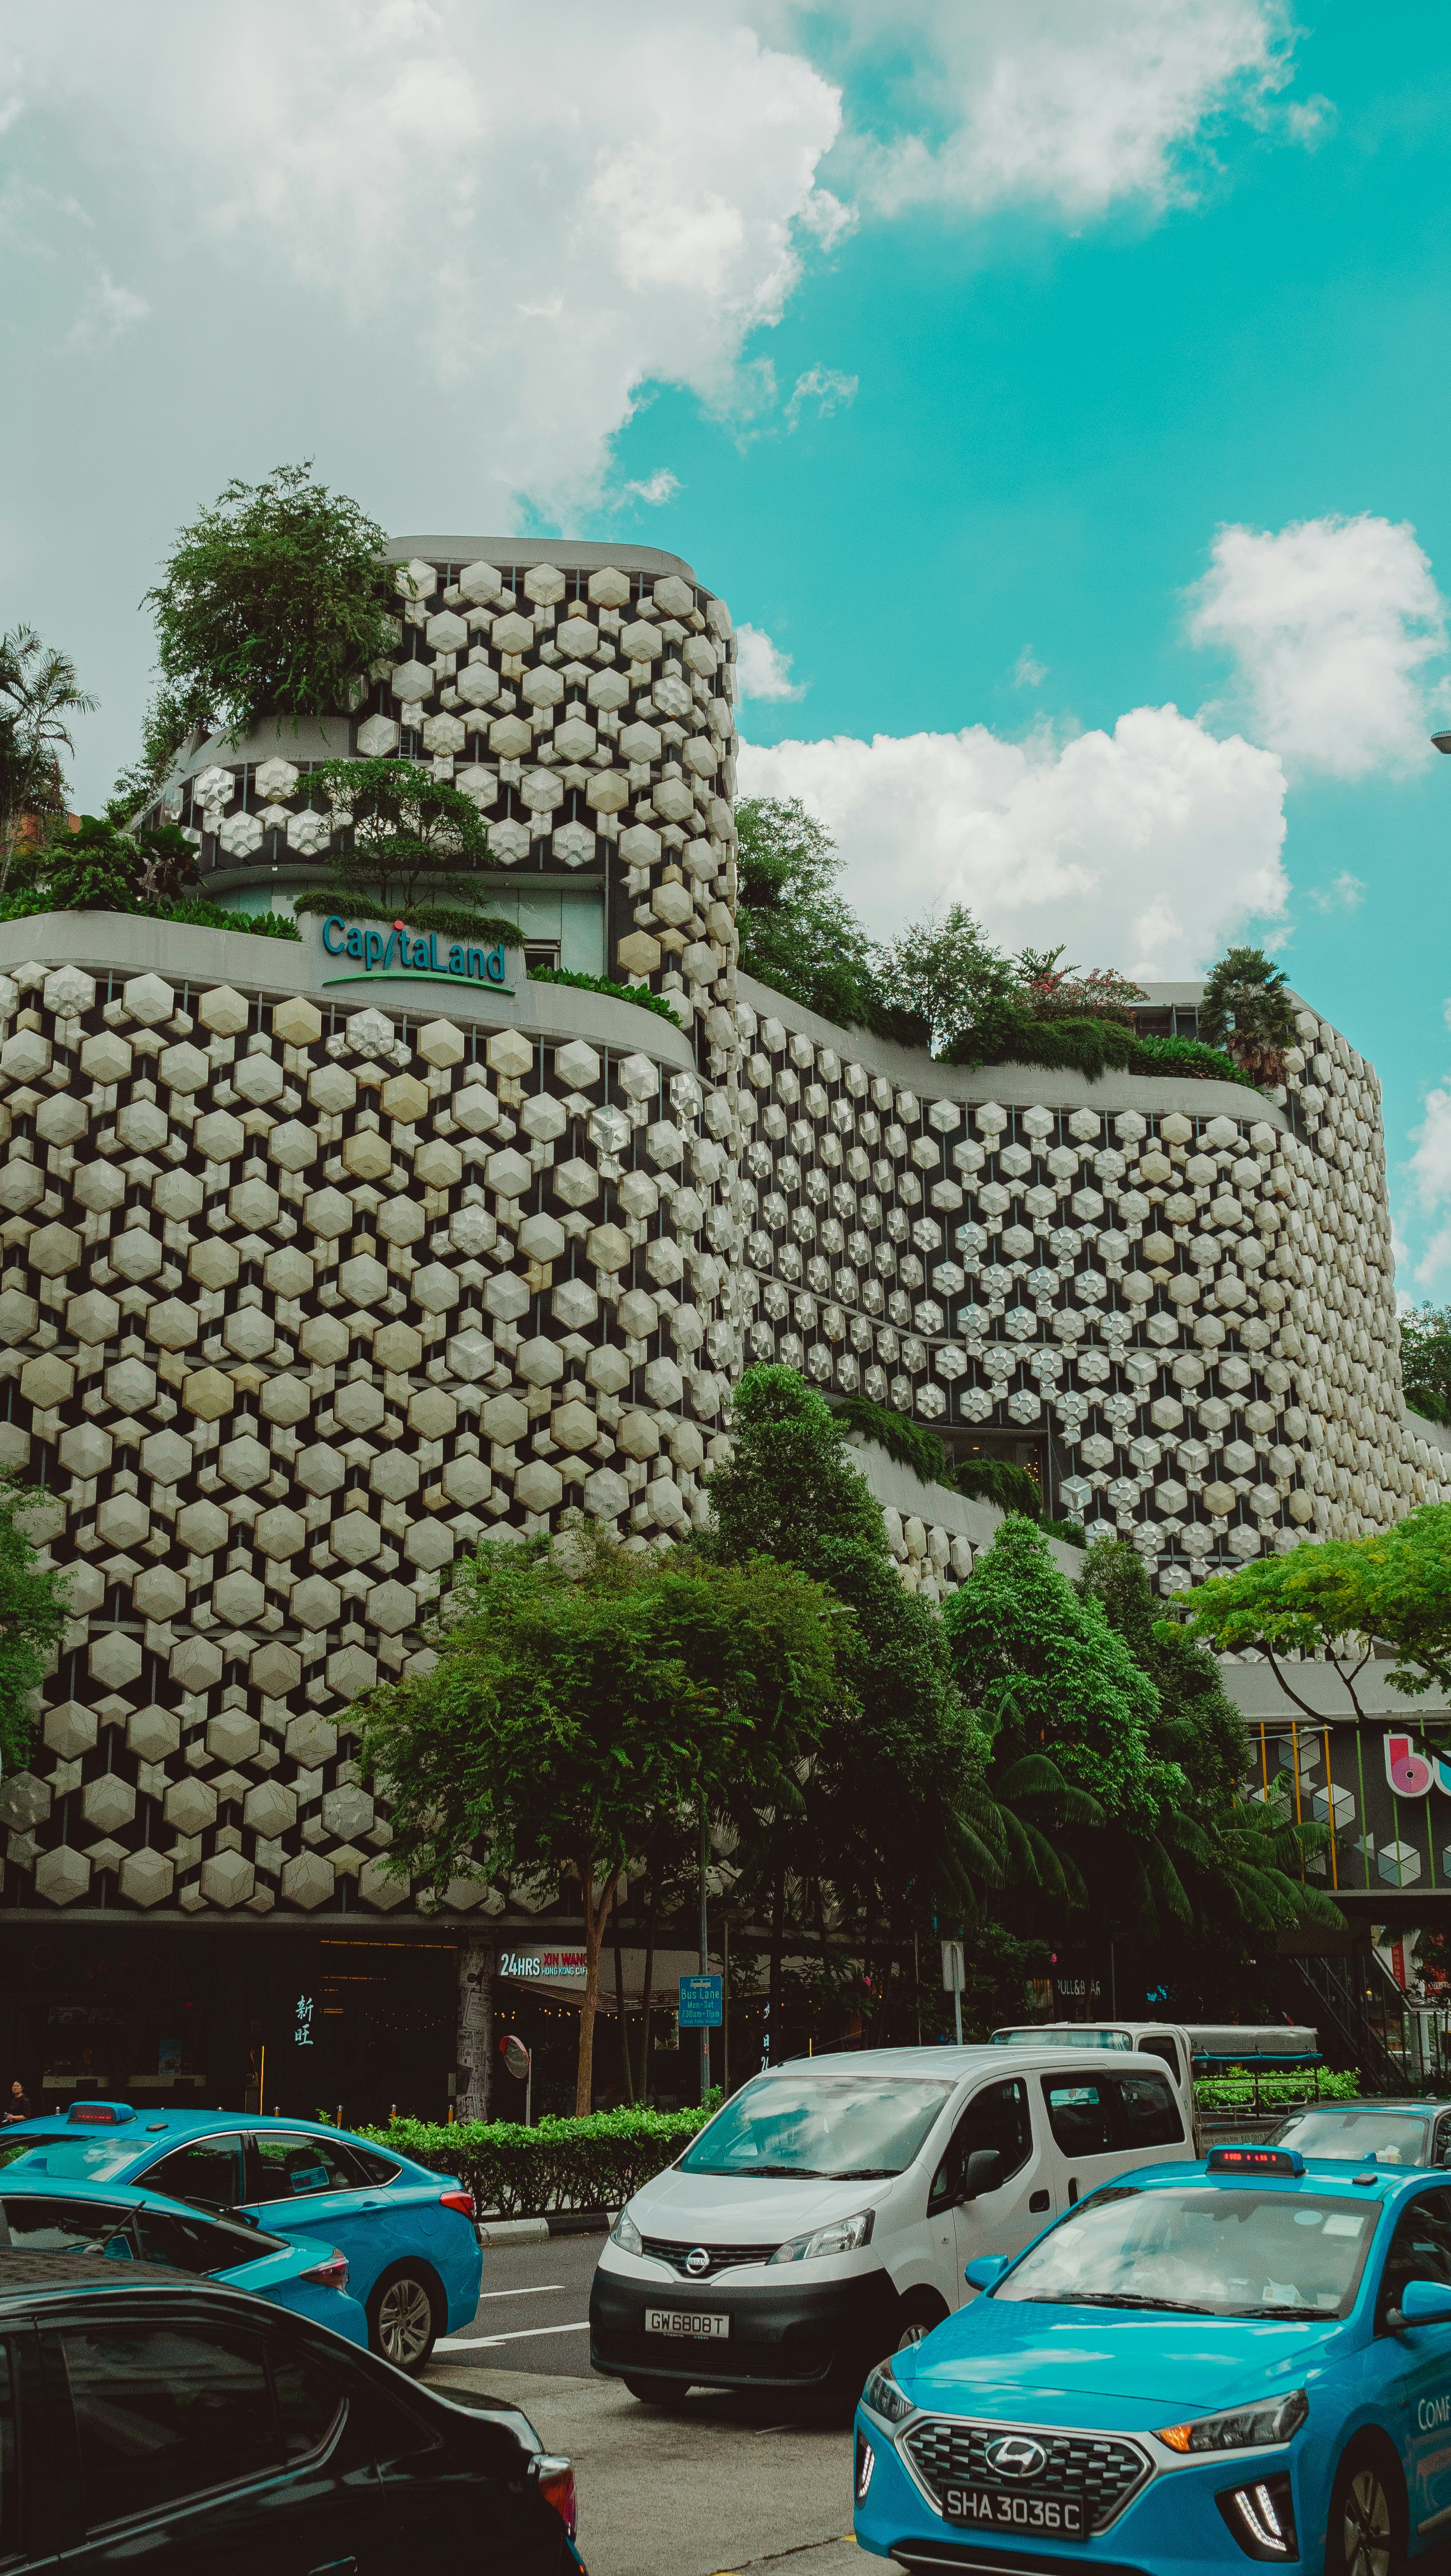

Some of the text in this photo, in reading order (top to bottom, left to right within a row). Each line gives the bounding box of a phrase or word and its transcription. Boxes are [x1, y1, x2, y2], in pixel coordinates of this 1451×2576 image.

[322, 915, 505, 982] CapitaLand
[501, 1953, 540, 1976] 24HRS
[544, 1953, 559, 1966] XIN
[542, 1966, 558, 1976] HONG
[559, 1966, 574, 1976] KONG
[681, 1988, 720, 2000] Bus Lane
[1057, 1979, 1101, 1996] ULL&BAR
[294, 1995, 314, 2046] 新旺
